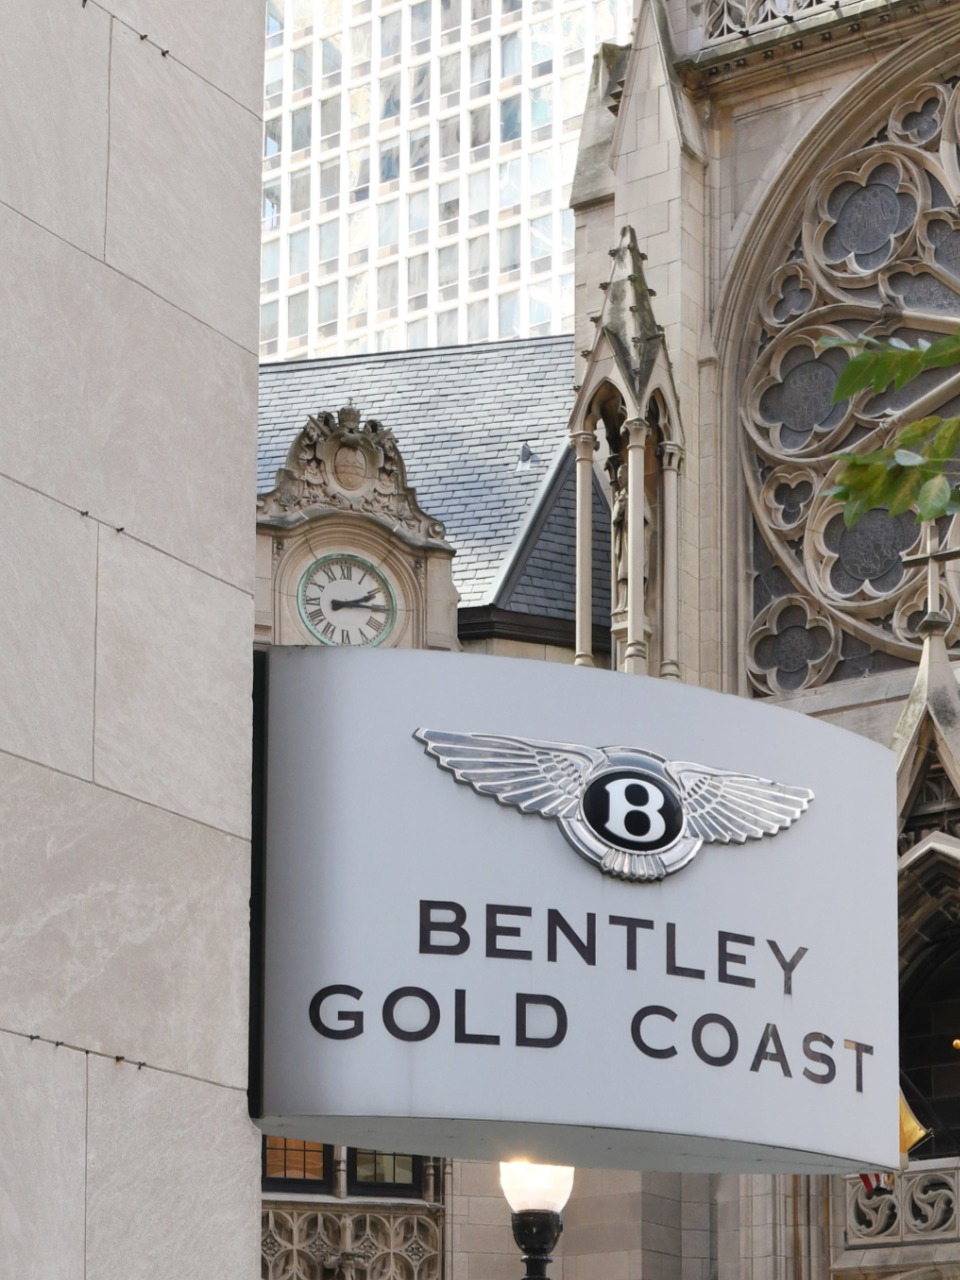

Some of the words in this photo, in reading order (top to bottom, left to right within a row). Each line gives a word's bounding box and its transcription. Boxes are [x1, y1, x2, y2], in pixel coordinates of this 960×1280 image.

[604, 778, 667, 843] B
[418, 899, 809, 995] BENTLEY
[308, 983, 568, 1049] GOLD
[630, 1004, 874, 1093] COAST
